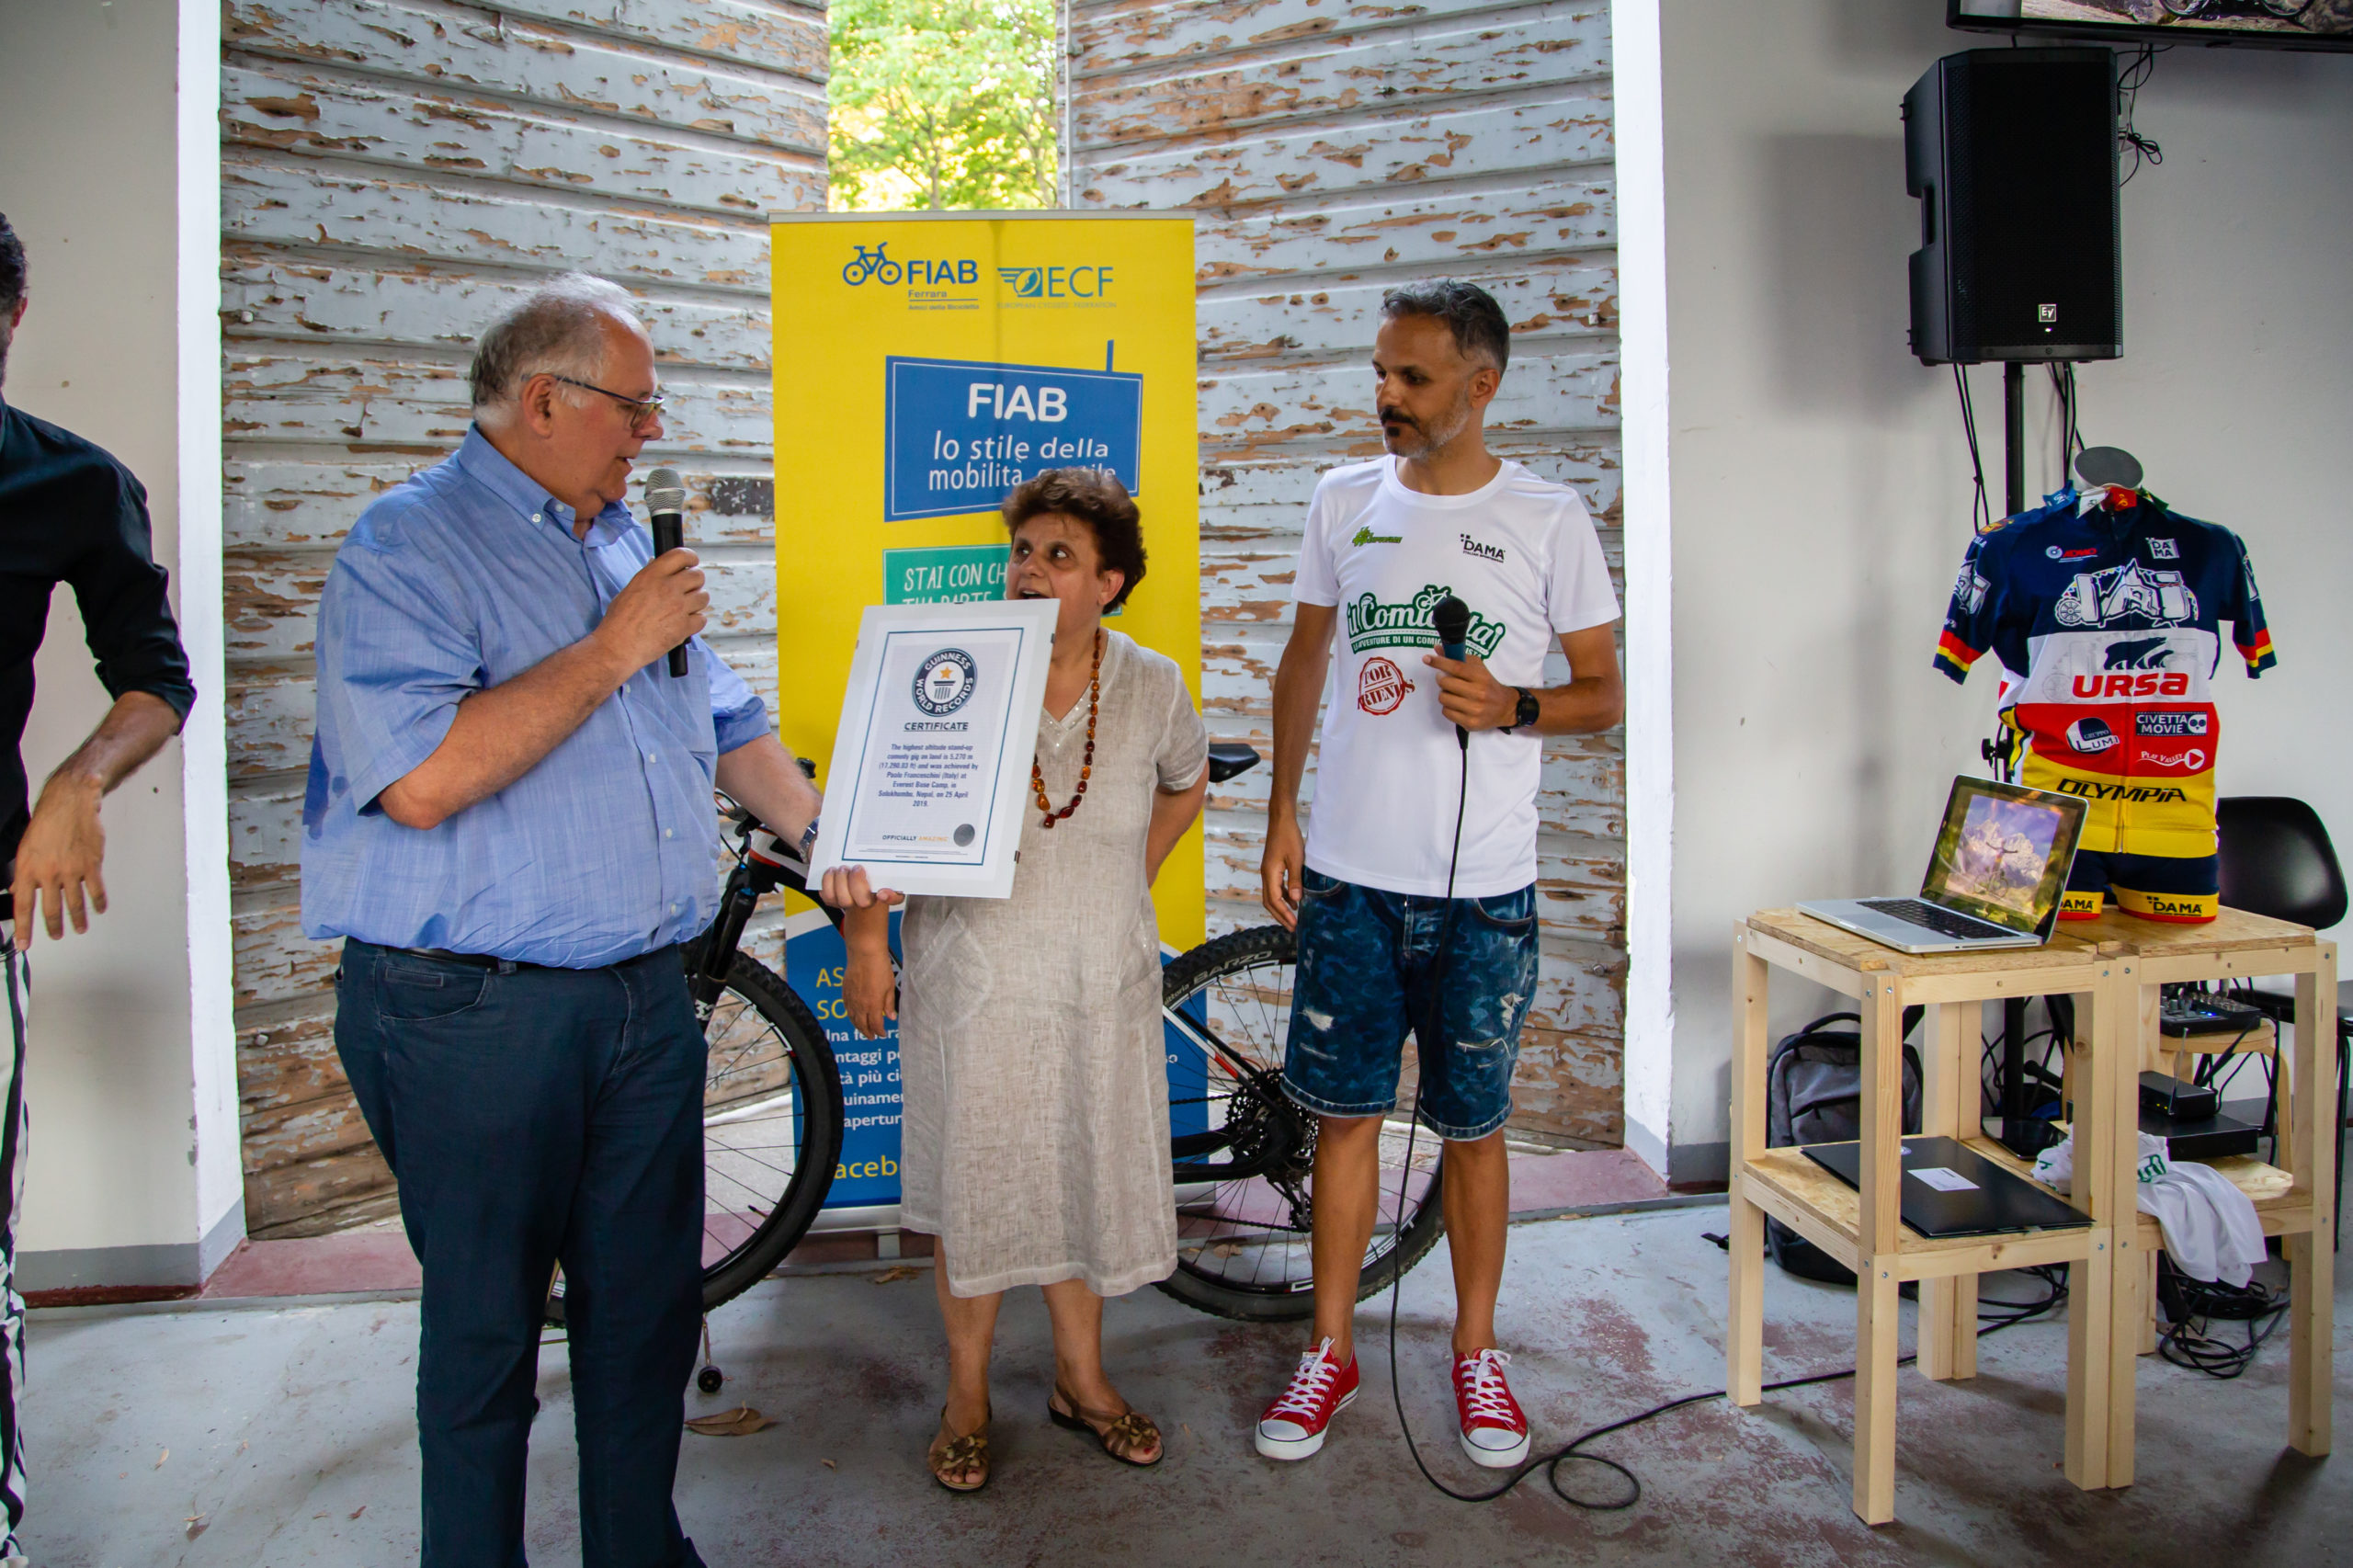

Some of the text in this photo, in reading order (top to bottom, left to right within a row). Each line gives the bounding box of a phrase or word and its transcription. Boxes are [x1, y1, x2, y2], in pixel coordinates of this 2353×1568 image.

[907, 259, 979, 285] FIAB
[1049, 266, 1114, 298] ECF
[908, 290, 948, 298] Ferrara
[968, 383, 1068, 422] FIAB
[934, 429, 1108, 460] lo stile della
[928, 458, 1023, 491] mobilità
[1463, 540, 1505, 561] DAMA
[904, 565, 945, 591] STAI
[949, 562, 983, 587] CON
[925, 652, 972, 671] GUINNESS
[1364, 664, 1392, 685] FOR
[915, 677, 973, 713] WORLD RECORDS
[904, 722, 969, 732] CERTIFICATE
[2136, 714, 2188, 725] CIVETTA
[2141, 723, 2183, 734] MOVIE
[903, 744, 924, 752] highest
[941, 772, 960, 780] (Italy)
[2154, 902, 2202, 914] DAMA
[1193, 950, 1272, 984] BARZO
[835, 1048, 881, 1066] ntaggi
[858, 1069, 882, 1087] più
[844, 1114, 903, 1131] apertur
[834, 1154, 899, 1179] aceb
